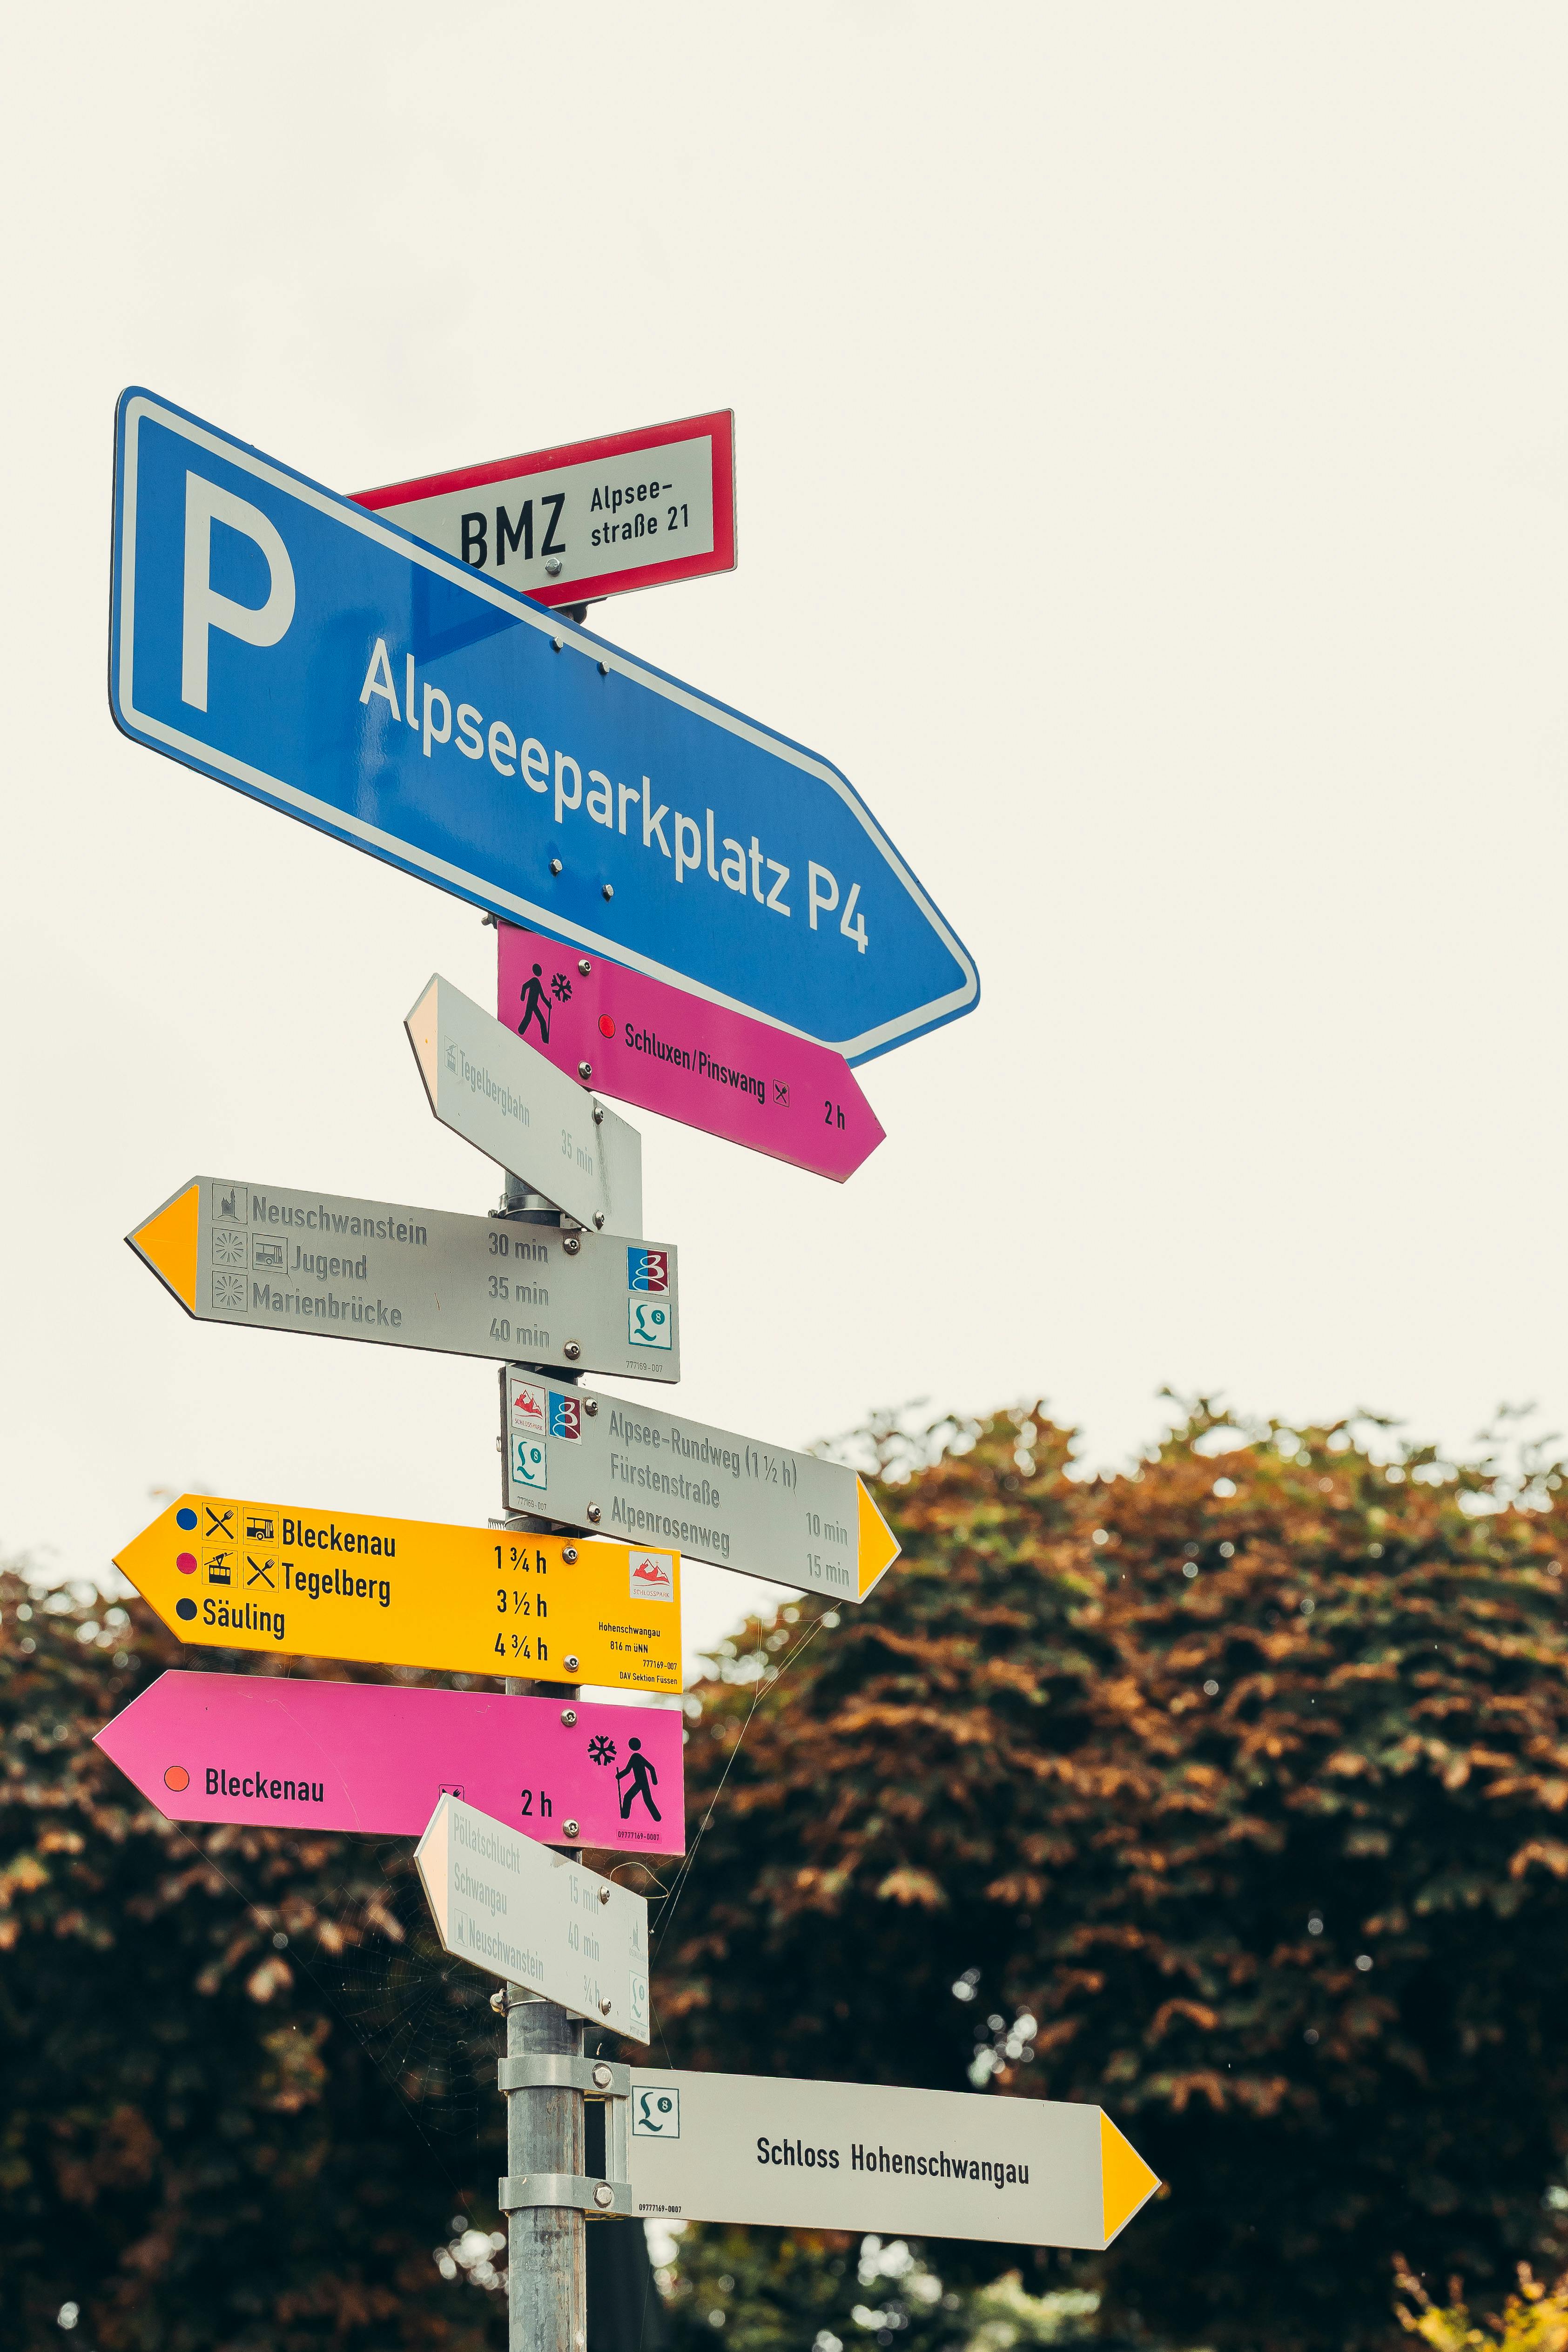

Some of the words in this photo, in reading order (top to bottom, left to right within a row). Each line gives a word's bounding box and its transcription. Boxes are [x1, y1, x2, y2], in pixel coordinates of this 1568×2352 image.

[591, 481, 673, 512] Alpsee-
[461, 493, 566, 569] BMZ
[591, 514, 658, 546] straße
[667, 504, 689, 531] 21
[182, 469, 296, 713] P
[359, 638, 790, 917] Alpseeparkplatz
[808, 861, 868, 954] P4
[625, 1023, 765, 1105] Schluxen/Pinswang
[824, 1101, 833, 1125] 2
[837, 1103, 846, 1131] h
[460, 1051, 530, 1127] Tegelbergbahn
[561, 1129, 572, 1159] 35
[577, 1147, 593, 1176] min
[253, 1196, 427, 1246] Neuschwanstein
[488, 1233, 509, 1256] 30
[515, 1239, 548, 1263] min
[290, 1246, 367, 1281] Jugend
[488, 1276, 509, 1300] 35
[516, 1282, 549, 1306] min
[253, 1283, 402, 1328] Marienbrücke
[490, 1318, 510, 1342] 40
[516, 1324, 550, 1348] min
[626, 1361, 663, 1373] 777169-007
[514, 1418, 543, 1431] SCHLOSSPARK
[609, 1410, 740, 1478] Alpsee-Rundweg
[517, 1496, 547, 1511] 777169-007
[611, 1453, 720, 1508] Fürstenstraße
[806, 1512, 820, 1537] 10
[824, 1521, 848, 1546] min
[283, 1518, 396, 1557] Bleckenau
[494, 1546, 502, 1569] 1
[536, 1550, 546, 1574] h
[611, 1496, 730, 1559] Alpenrosenweg
[807, 1553, 821, 1578] 15
[826, 1562, 849, 1587] min
[282, 1563, 390, 1608] Tegelberg
[497, 1590, 507, 1613] 3
[537, 1594, 547, 1617] h
[633, 1588, 670, 1598] SCHLOSSPARK
[203, 1598, 285, 1640] Säuling
[494, 1633, 505, 1656] 4
[538, 1638, 548, 1661] h
[599, 1622, 660, 1638] Hohenschwangau
[610, 1641, 623, 1651] 816
[633, 1643, 648, 1653] üNN
[619, 1671, 631, 1680] DAV
[633, 1672, 655, 1683] Sektion
[657, 1675, 678, 1685] Füssen
[643, 1659, 678, 1671] 777169-007
[206, 1768, 324, 1802] Bleckenau
[521, 1789, 533, 1816] 2
[540, 1790, 552, 1817] h
[618, 1830, 660, 1841] 09777169-0007
[454, 1813, 521, 1874] Pöllatschlucht
[569, 1874, 579, 1904] 15
[583, 1886, 599, 1915] min
[454, 1862, 507, 1917] Schwangau
[568, 1921, 579, 1951] 40
[584, 1932, 599, 1961] min
[469, 1918, 544, 1981] Neuschwanstein
[595, 1981, 600, 2008] h
[757, 2137, 840, 2169] Schloss
[851, 2143, 1029, 2189] Hohenschwangau
[639, 2204, 682, 2213] 09777169-0007
